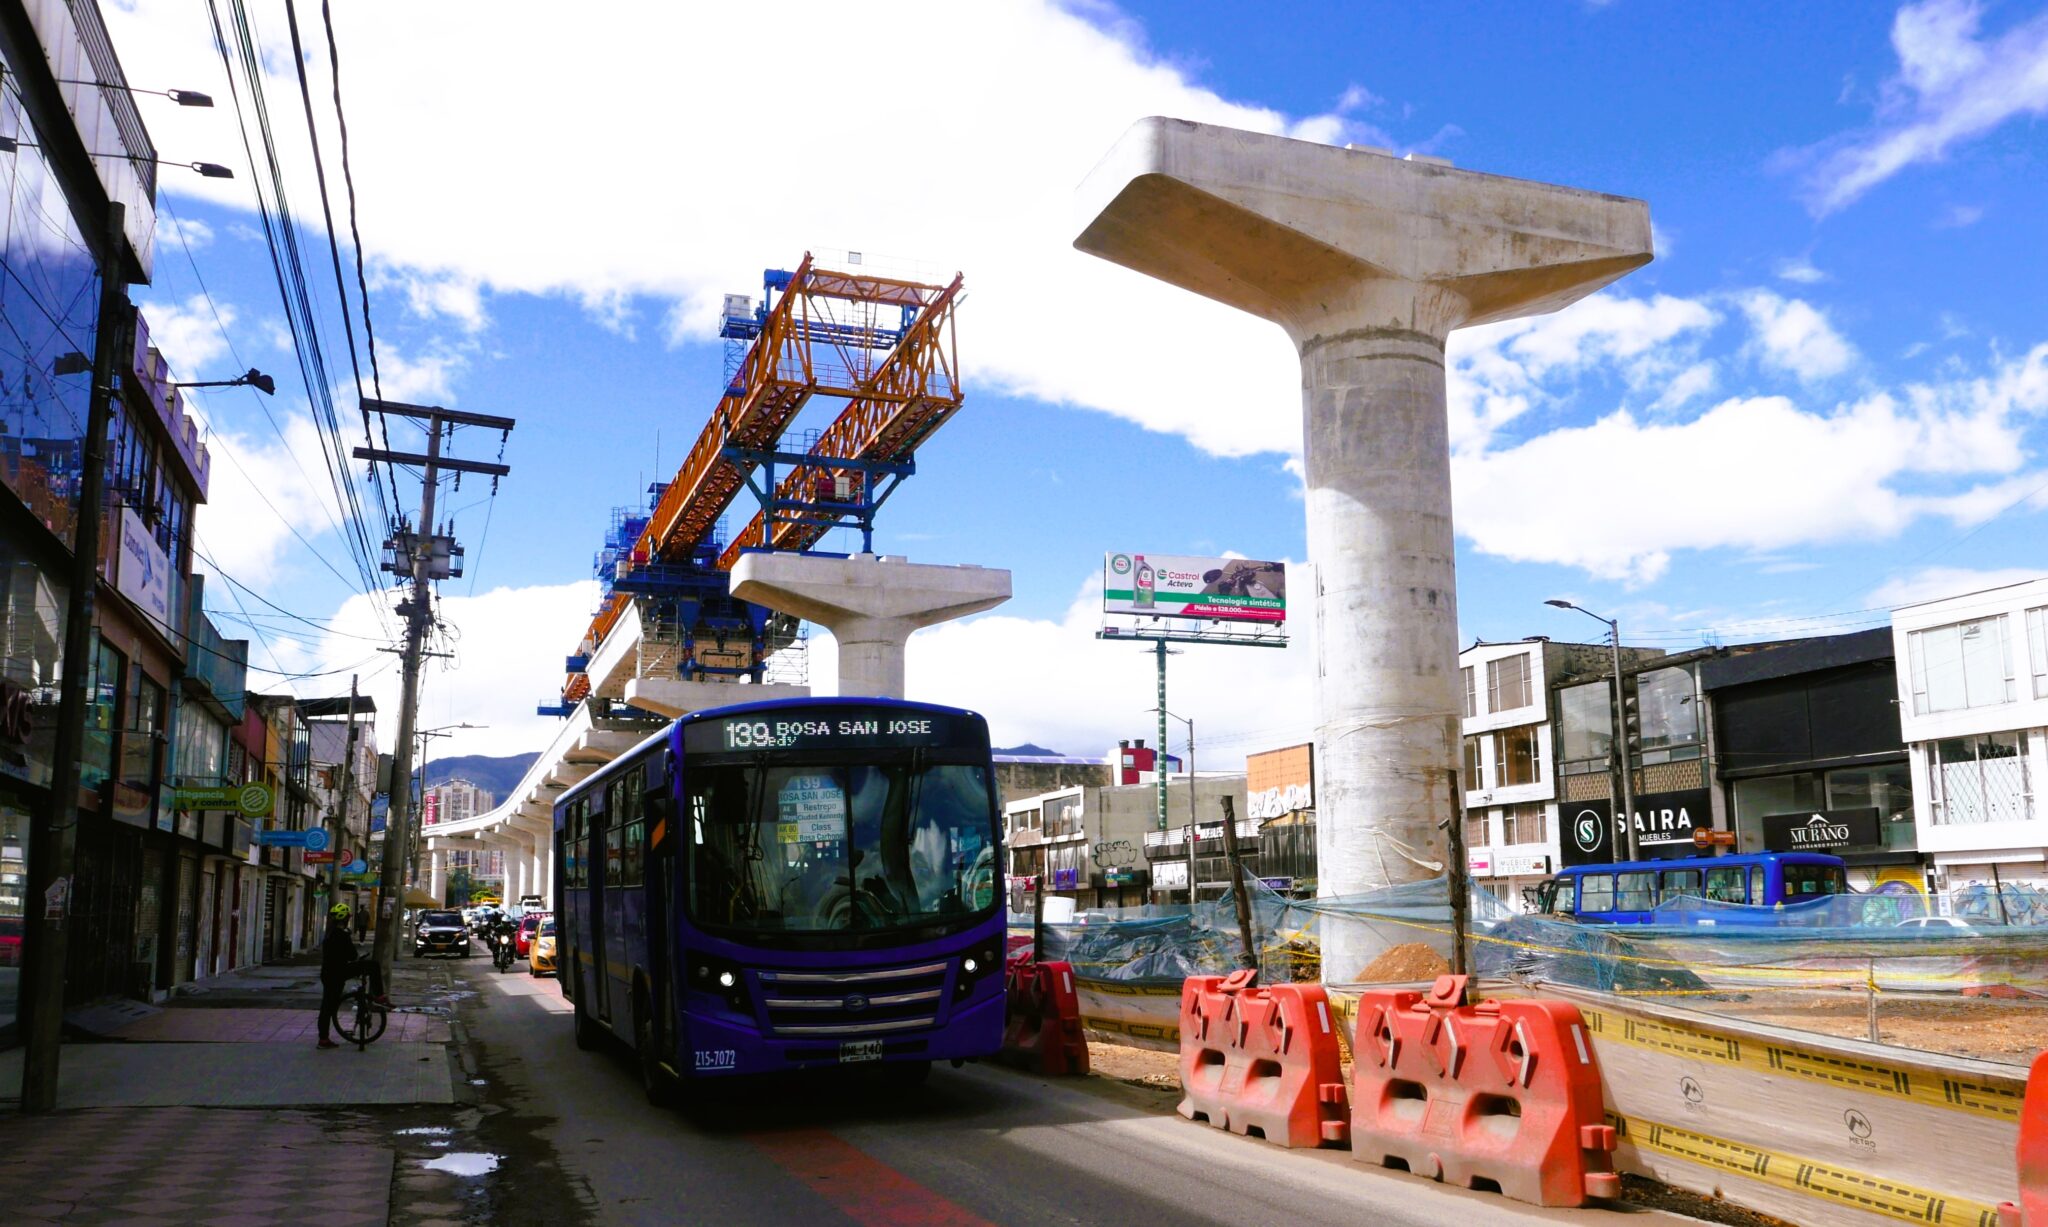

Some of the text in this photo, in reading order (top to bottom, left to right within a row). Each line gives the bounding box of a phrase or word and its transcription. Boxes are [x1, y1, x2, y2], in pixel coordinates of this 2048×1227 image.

[1168, 571, 1200, 580] Castrol
[1167, 580, 1193, 588] Actevo
[726, 720, 931, 747] 139 BOSA SAN JOSE
[797, 777, 820, 790] 139
[176, 790, 225, 800] Elegancia
[801, 791, 818, 801] SAN
[200, 799, 237, 807] confort
[803, 803, 837, 812] Restrepo
[819, 813, 844, 822] Kennedy
[1617, 807, 1692, 833] SAIRA
[811, 822, 832, 831] Class
[800, 834, 816, 842] Bosa
[1638, 832, 1671, 841] MUEBLES
[1790, 826, 1849, 843] MURANO
[695, 1049, 736, 1066] Z15-7072
[1849, 1135, 1876, 1148] METRO
